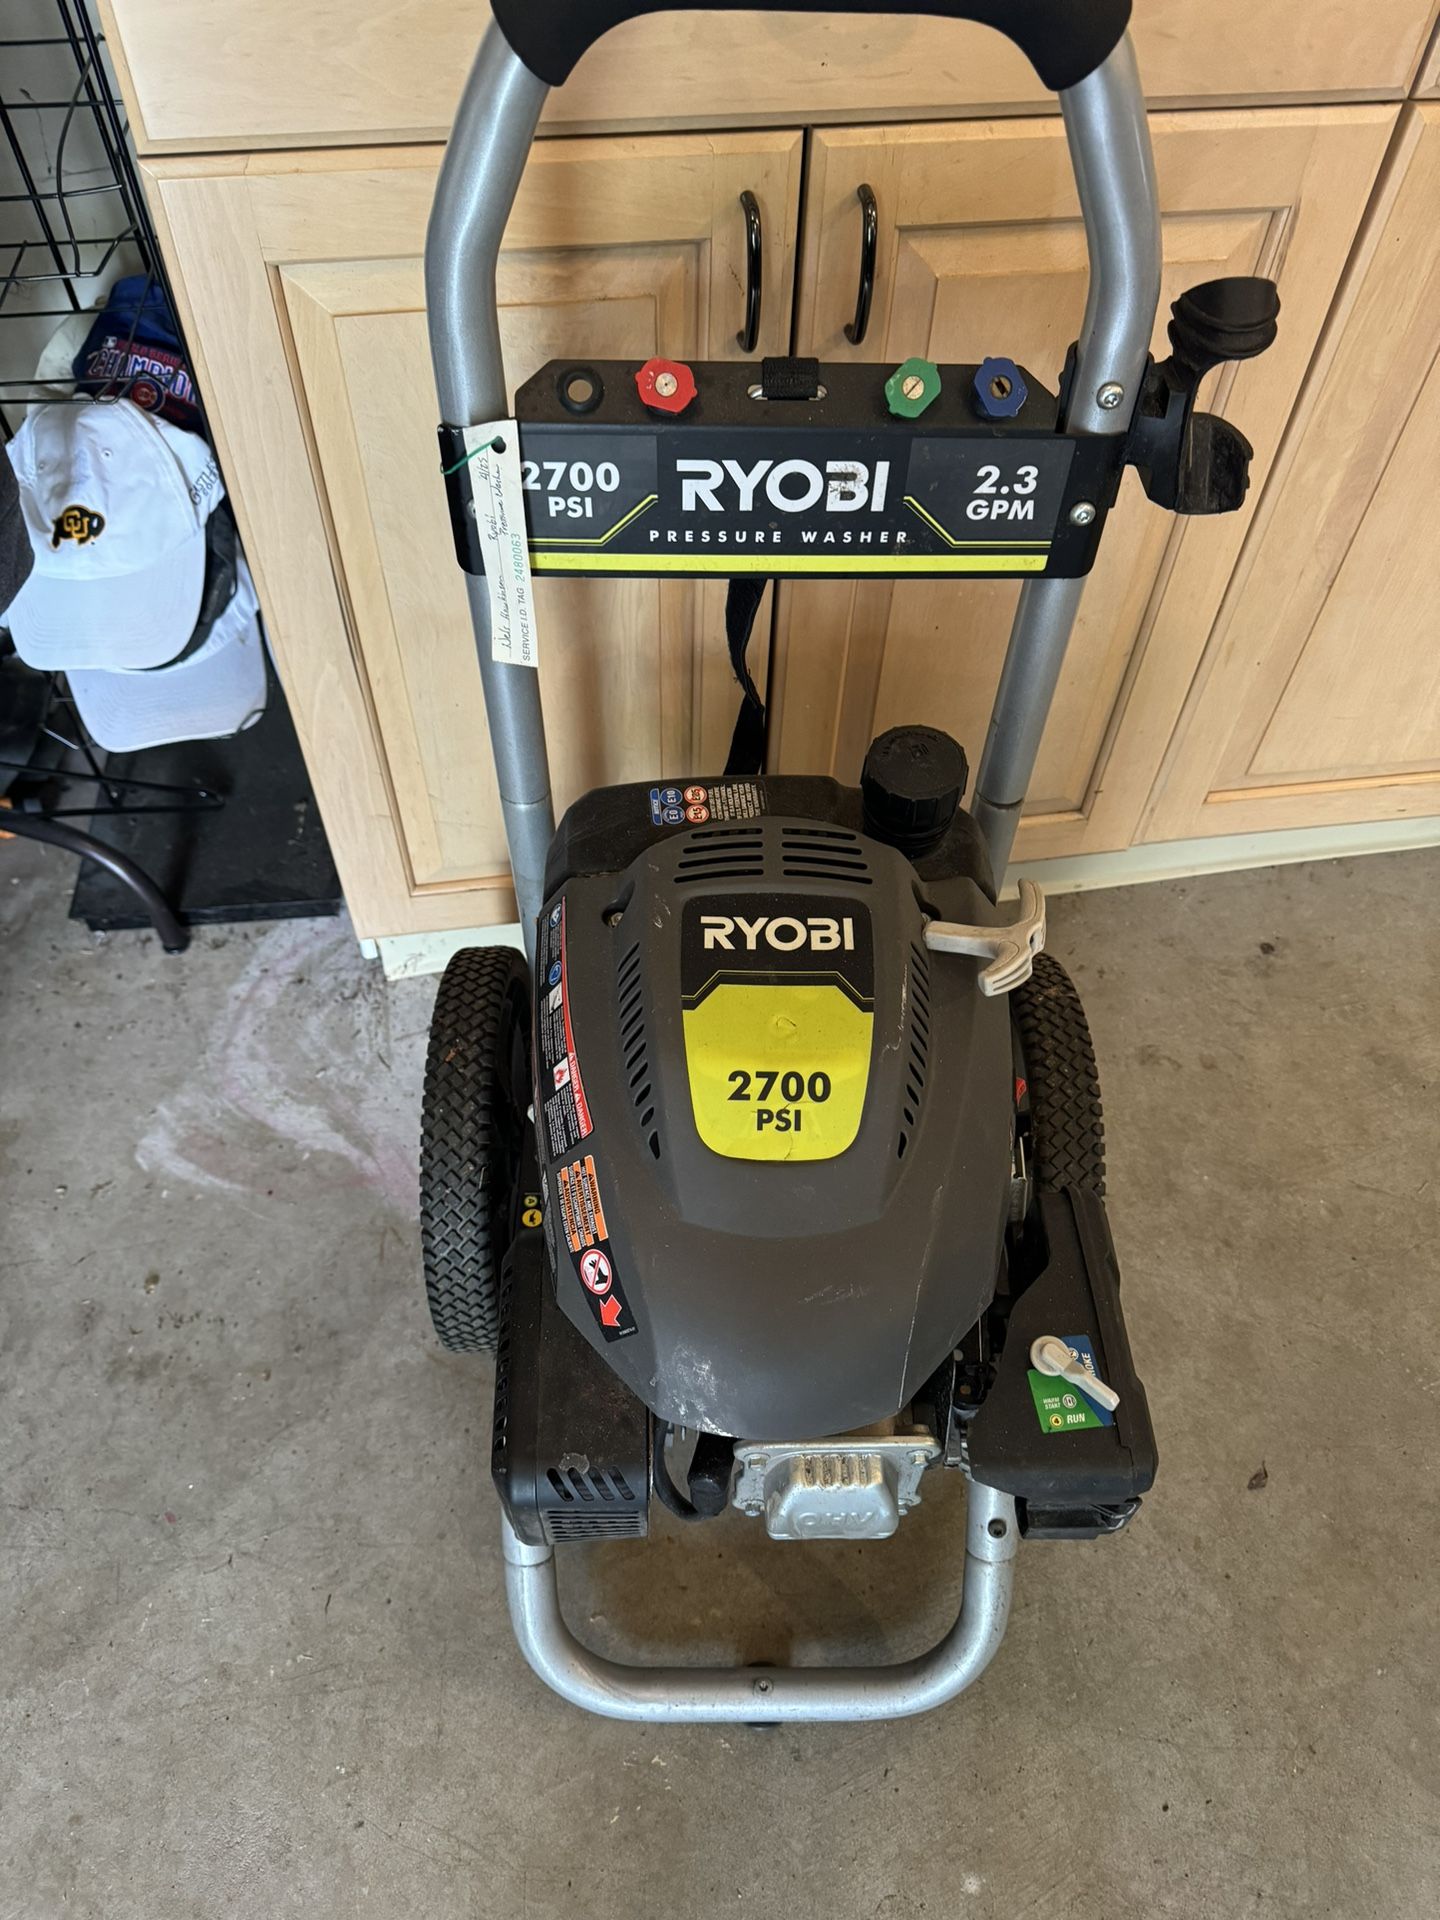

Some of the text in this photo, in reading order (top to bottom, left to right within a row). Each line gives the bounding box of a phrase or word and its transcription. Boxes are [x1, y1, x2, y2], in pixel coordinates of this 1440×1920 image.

[521, 461, 620, 492] 2700
[676, 459, 890, 513] RYOBI
[973, 465, 1039, 494] 2.3
[548, 496, 593, 518] PSI
[966, 499, 1035, 520] GPM
[650, 530, 907, 543] PRESSURE WASHER
[510, 532, 530, 661] SERVICE I.D. TAG 2480063
[666, 790, 678, 819] E0 E10
[701, 916, 855, 951] RYOBI
[728, 1070, 831, 1103] 2700
[576, 1102, 588, 1136] DANGER
[756, 1109, 801, 1131] PSI
[565, 1188, 576, 1235] ADVERTENCIA
[577, 1179, 590, 1235] AVERTISSEMENT
[590, 1179, 600, 1214] WARNING
[1044, 1402, 1061, 1410] START
[1067, 1412, 1085, 1424] RUN
